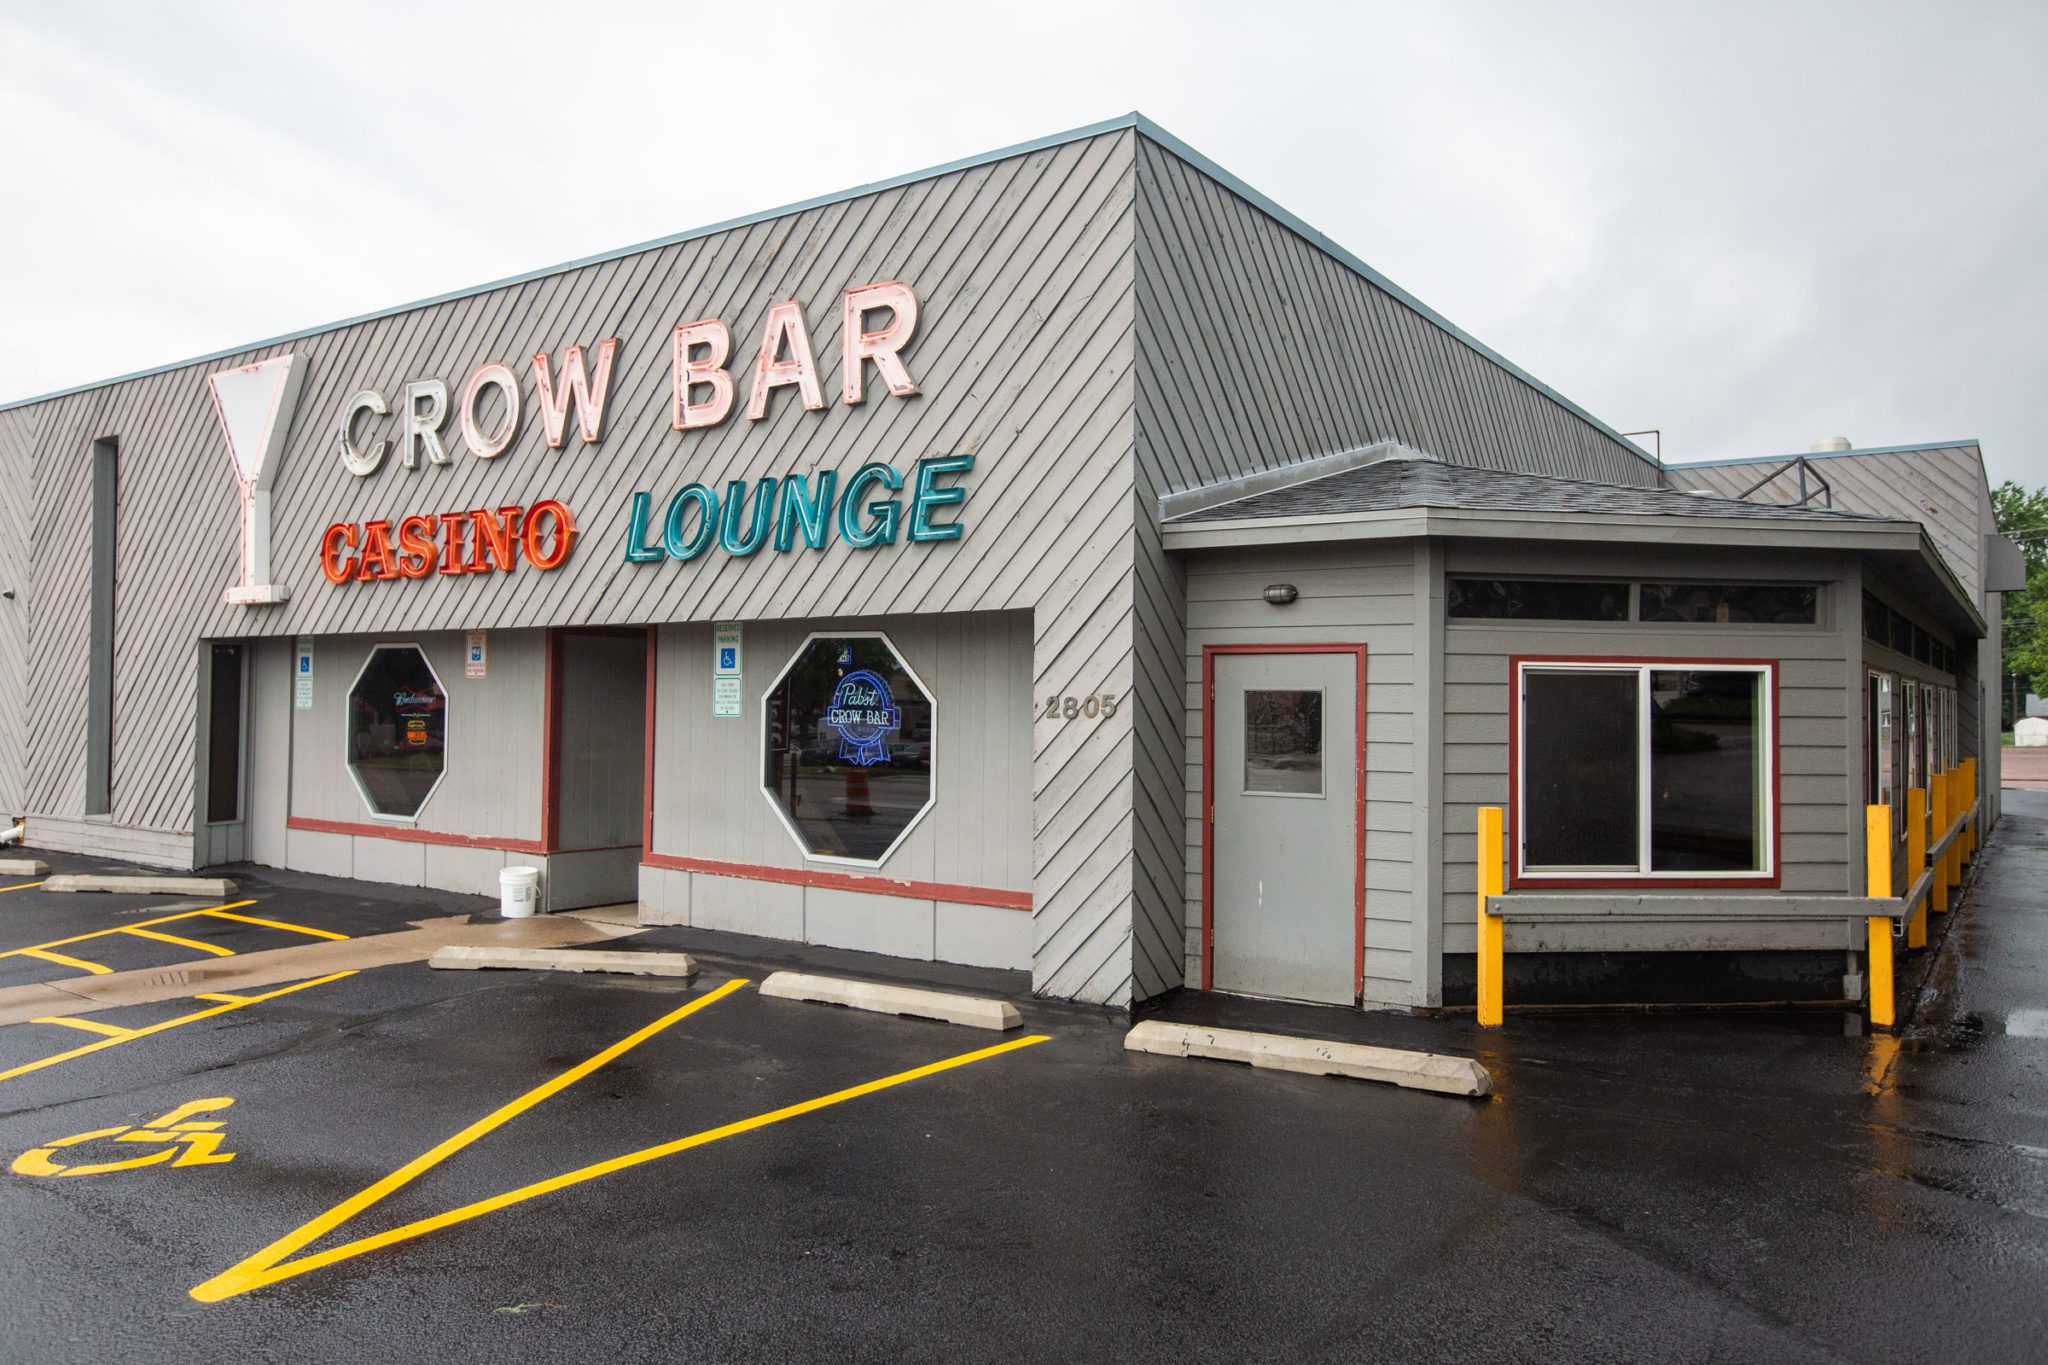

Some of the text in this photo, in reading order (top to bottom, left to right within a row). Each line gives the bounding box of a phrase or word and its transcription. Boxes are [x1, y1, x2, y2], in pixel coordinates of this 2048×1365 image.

[339, 280, 923, 477] CROW BAR
[320, 454, 975, 585] CASINO LOUNGE
[842, 683, 877, 706] Pabst
[1046, 694, 1117, 720] 2805
[831, 709, 890, 726] CROW BAR
